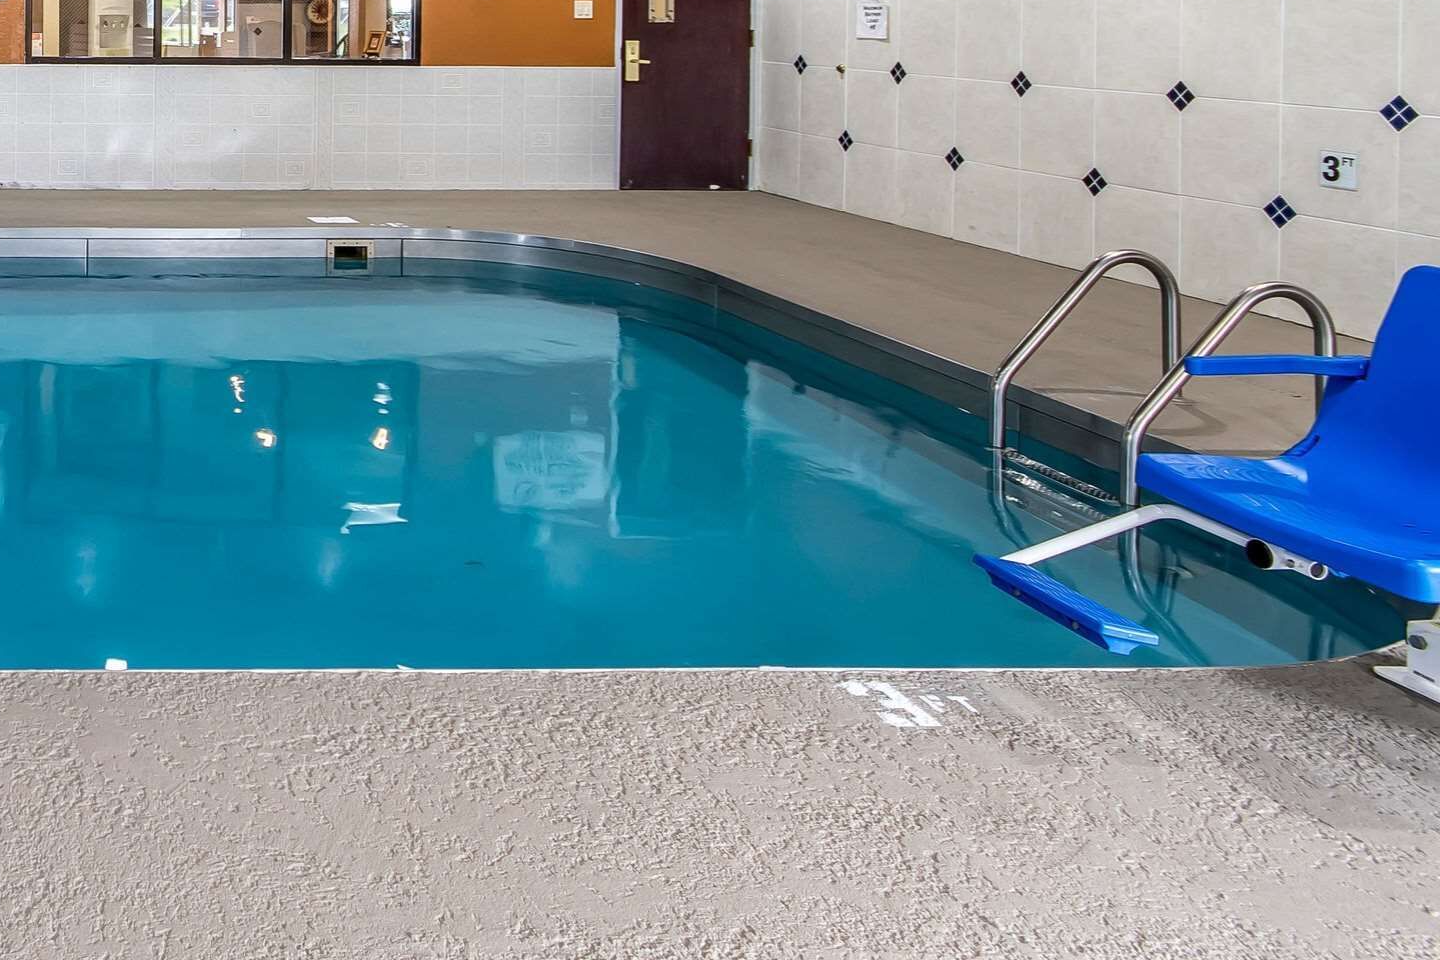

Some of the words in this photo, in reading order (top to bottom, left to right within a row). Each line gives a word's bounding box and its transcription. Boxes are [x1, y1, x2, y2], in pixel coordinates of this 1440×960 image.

[1322, 156, 1340, 182] 3
[1342, 157, 1355, 167] FT
[836, 680, 943, 727] 3
[918, 694, 979, 713] FT
